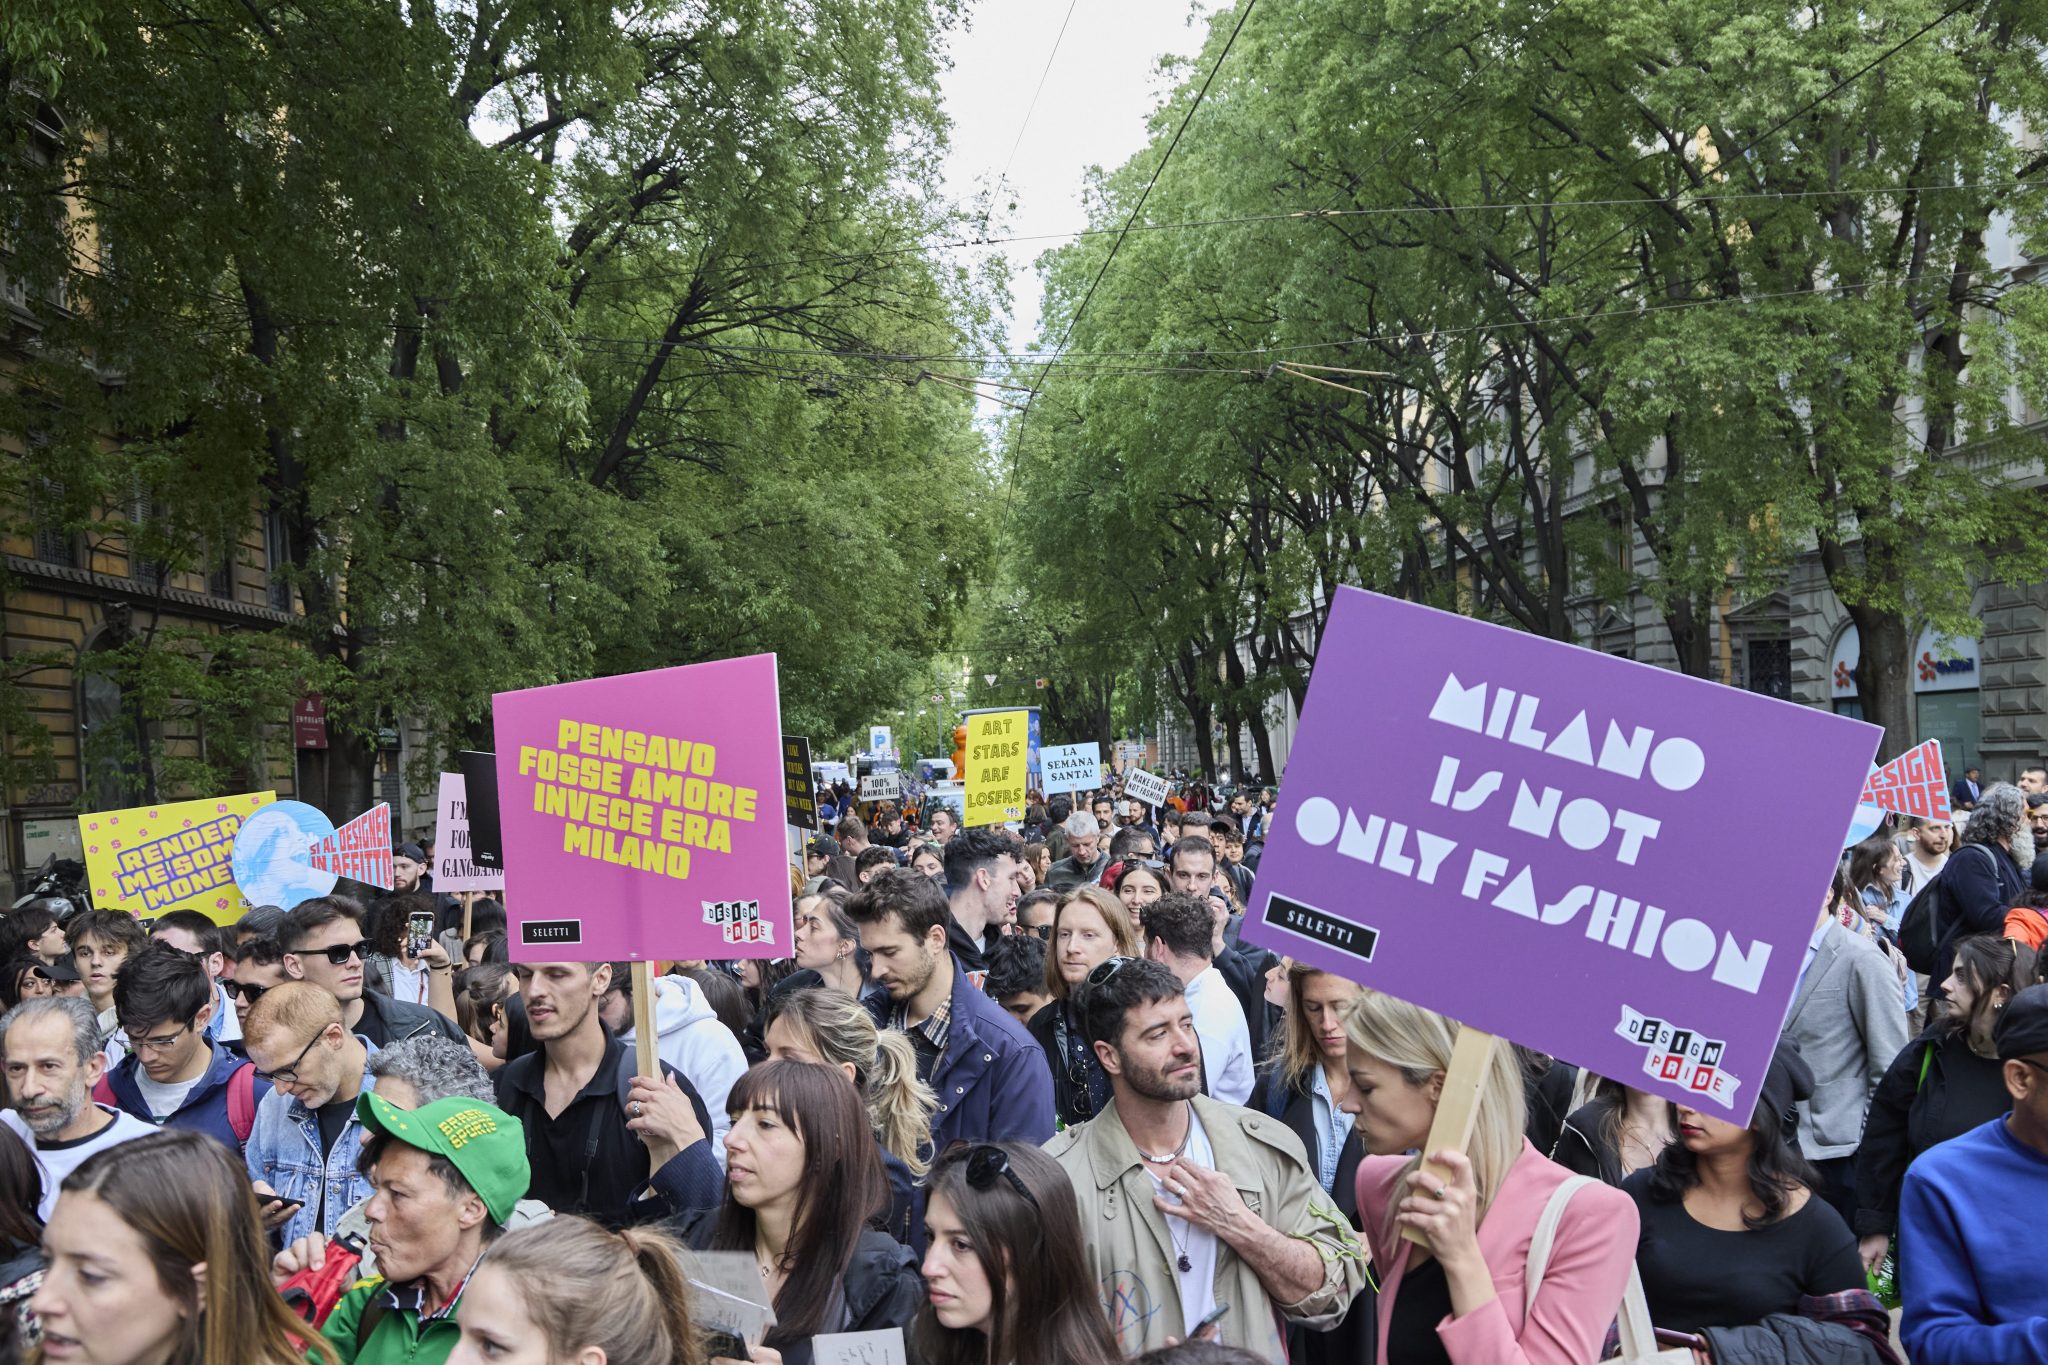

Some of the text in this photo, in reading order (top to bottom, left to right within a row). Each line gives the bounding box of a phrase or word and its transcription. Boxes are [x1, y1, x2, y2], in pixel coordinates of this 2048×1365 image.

[982, 719, 1013, 736] ART
[1429, 672, 1705, 791] MILANO
[558, 719, 716, 777] PENSAVO
[973, 742, 1020, 760] STARS
[1047, 757, 1094, 770] SEMANA
[1062, 747, 1077, 757] LA
[519, 745, 758, 822] FOSSE AMORE
[871, 778, 890, 788] 100%
[981, 766, 1010, 783] ARE
[1051, 769, 1093, 782] SANTA!
[1132, 772, 1167, 793] MAKE LOVE
[1864, 742, 1943, 791] ESIGN
[864, 787, 898, 798] ANIMAL FREE
[967, 788, 1022, 808] LOSERS
[1128, 782, 1163, 801] NOT FASHION
[534, 781, 732, 854] INVECE ERA
[1430, 755, 1661, 866] IS NOT
[119, 816, 240, 873] RENDER
[309, 805, 390, 855] SI AL DESIGNER
[119, 840, 233, 895] ME SOM
[563, 822, 691, 880] MILANO
[144, 862, 233, 909] MONE
[311, 848, 392, 889] IN AFFITTO
[708, 906, 758, 919] DESIGN
[1295, 796, 1773, 995] ONLY FASHION
[533, 927, 569, 937] SELETTI
[726, 925, 766, 938] PRIDE
[1287, 910, 1353, 944] SELETTI
[1629, 1020, 1720, 1063] DESIGN
[1651, 1055, 1724, 1092] PRIDE
[449, 1118, 497, 1149] SPORTS
